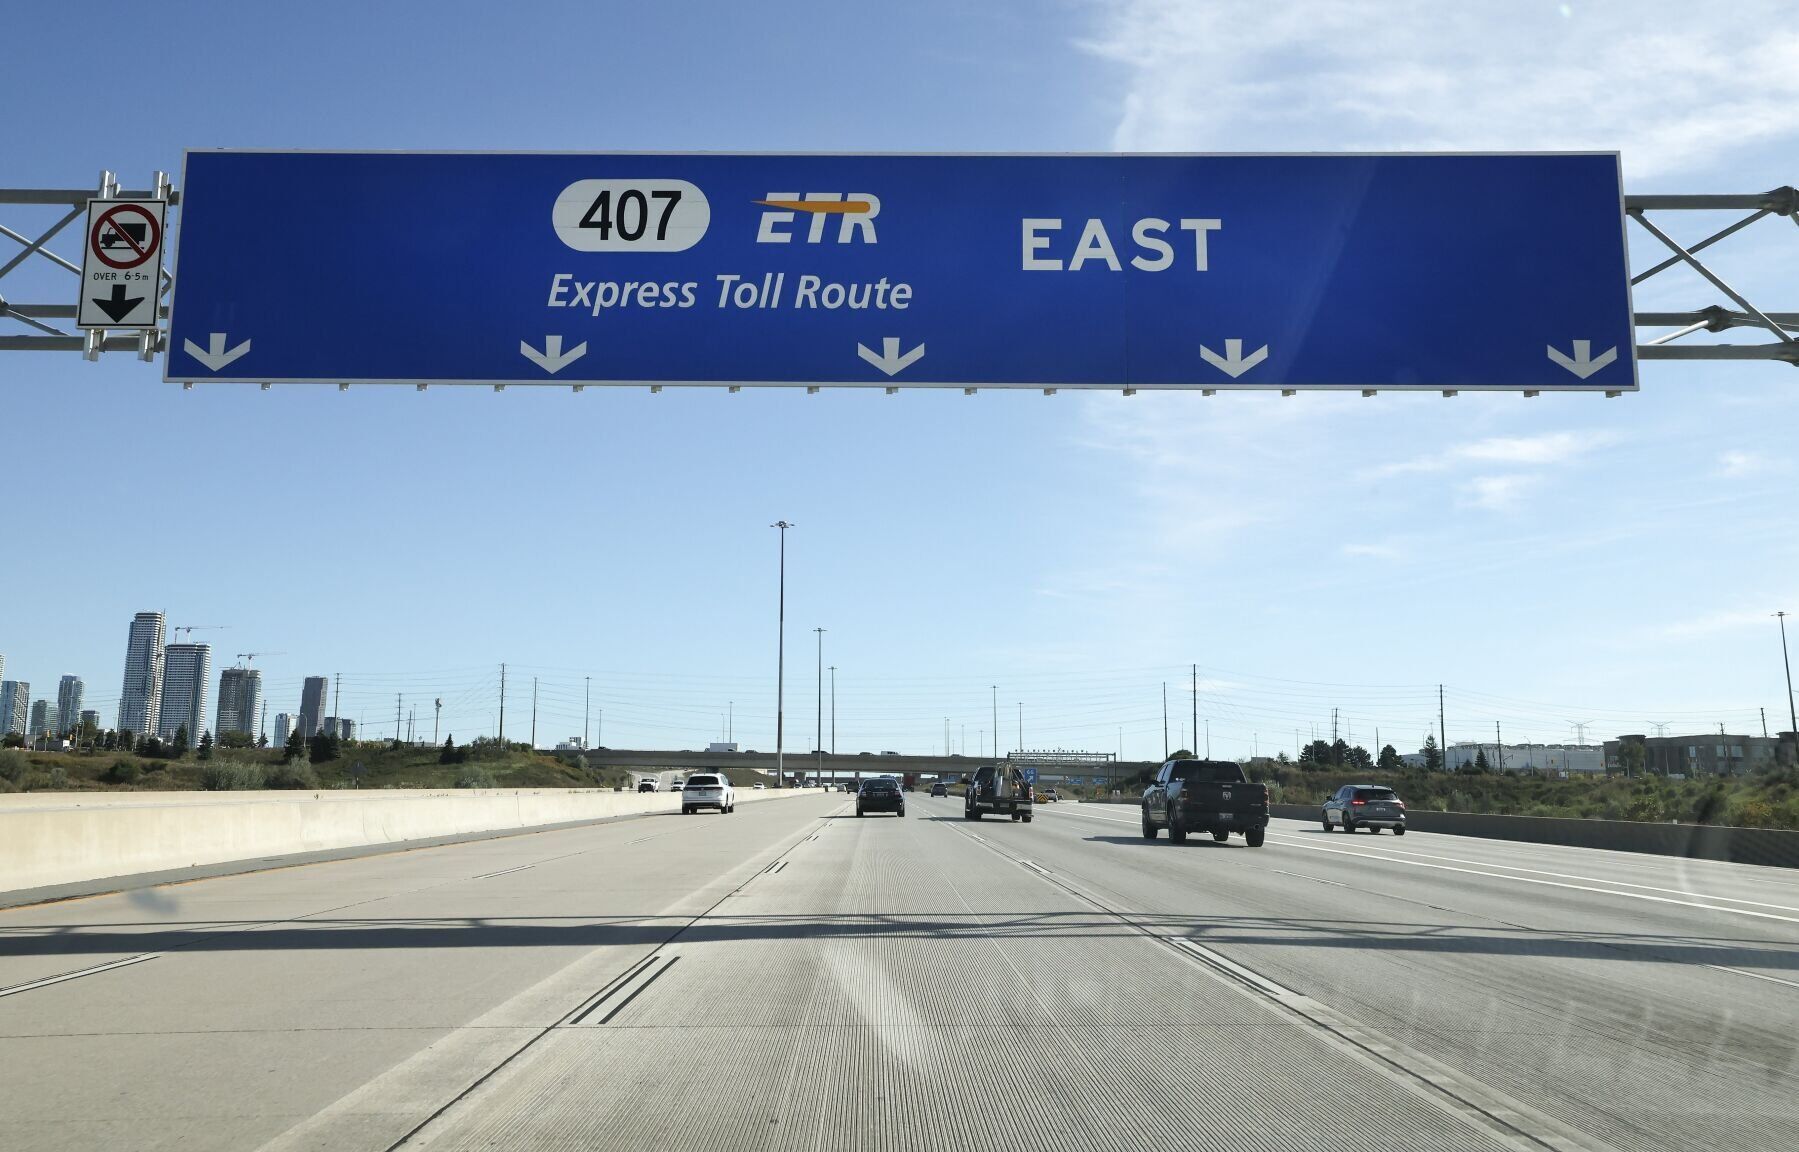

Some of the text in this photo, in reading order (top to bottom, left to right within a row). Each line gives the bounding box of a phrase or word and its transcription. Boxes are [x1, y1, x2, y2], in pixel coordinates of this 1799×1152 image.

[579, 190, 881, 244] 407 ETR
[1022, 218, 1222, 272] EAST
[93, 272, 117, 281] OVER
[548, 273, 913, 317] Express Toll Route
